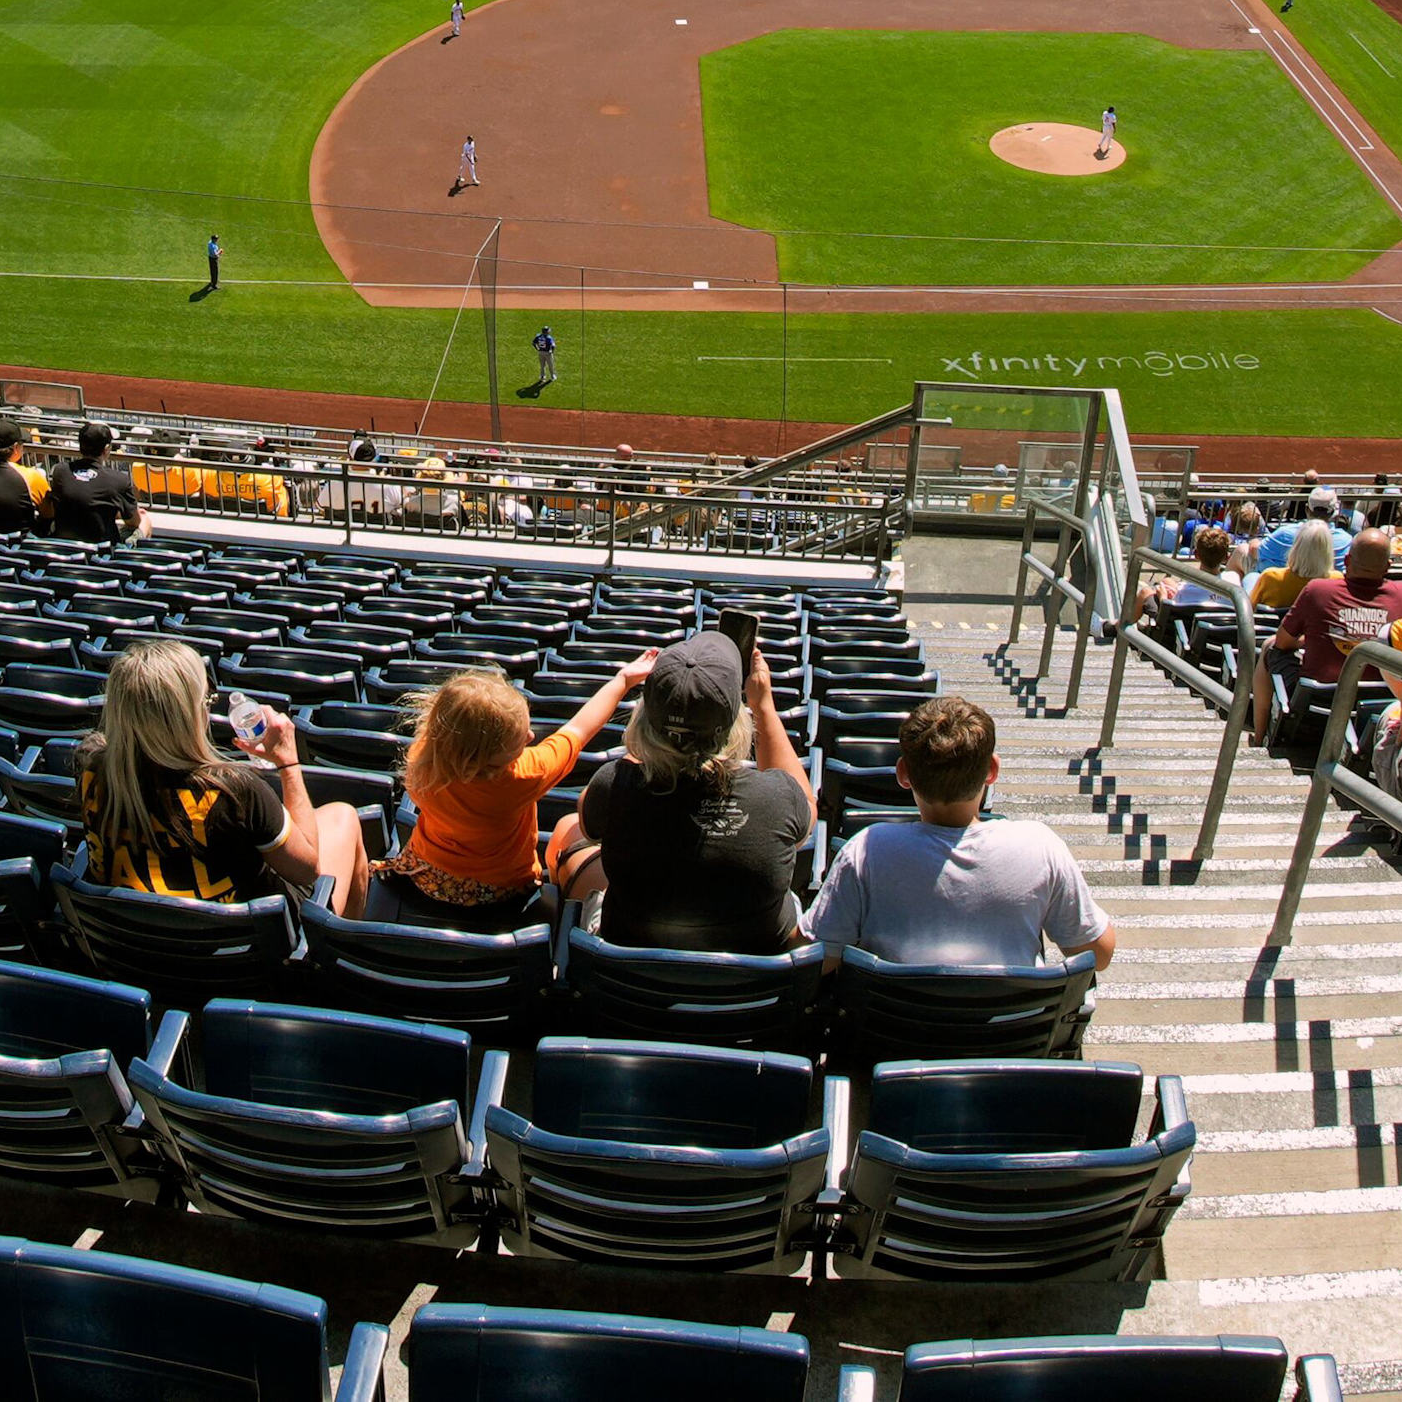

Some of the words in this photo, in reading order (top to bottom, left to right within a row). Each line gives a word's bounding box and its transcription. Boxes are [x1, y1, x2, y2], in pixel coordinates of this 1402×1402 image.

[939, 351, 1089, 380] xfinity
[1097, 351, 1260, 378] mobile
[1346, 621, 1382, 636] VALLEY
